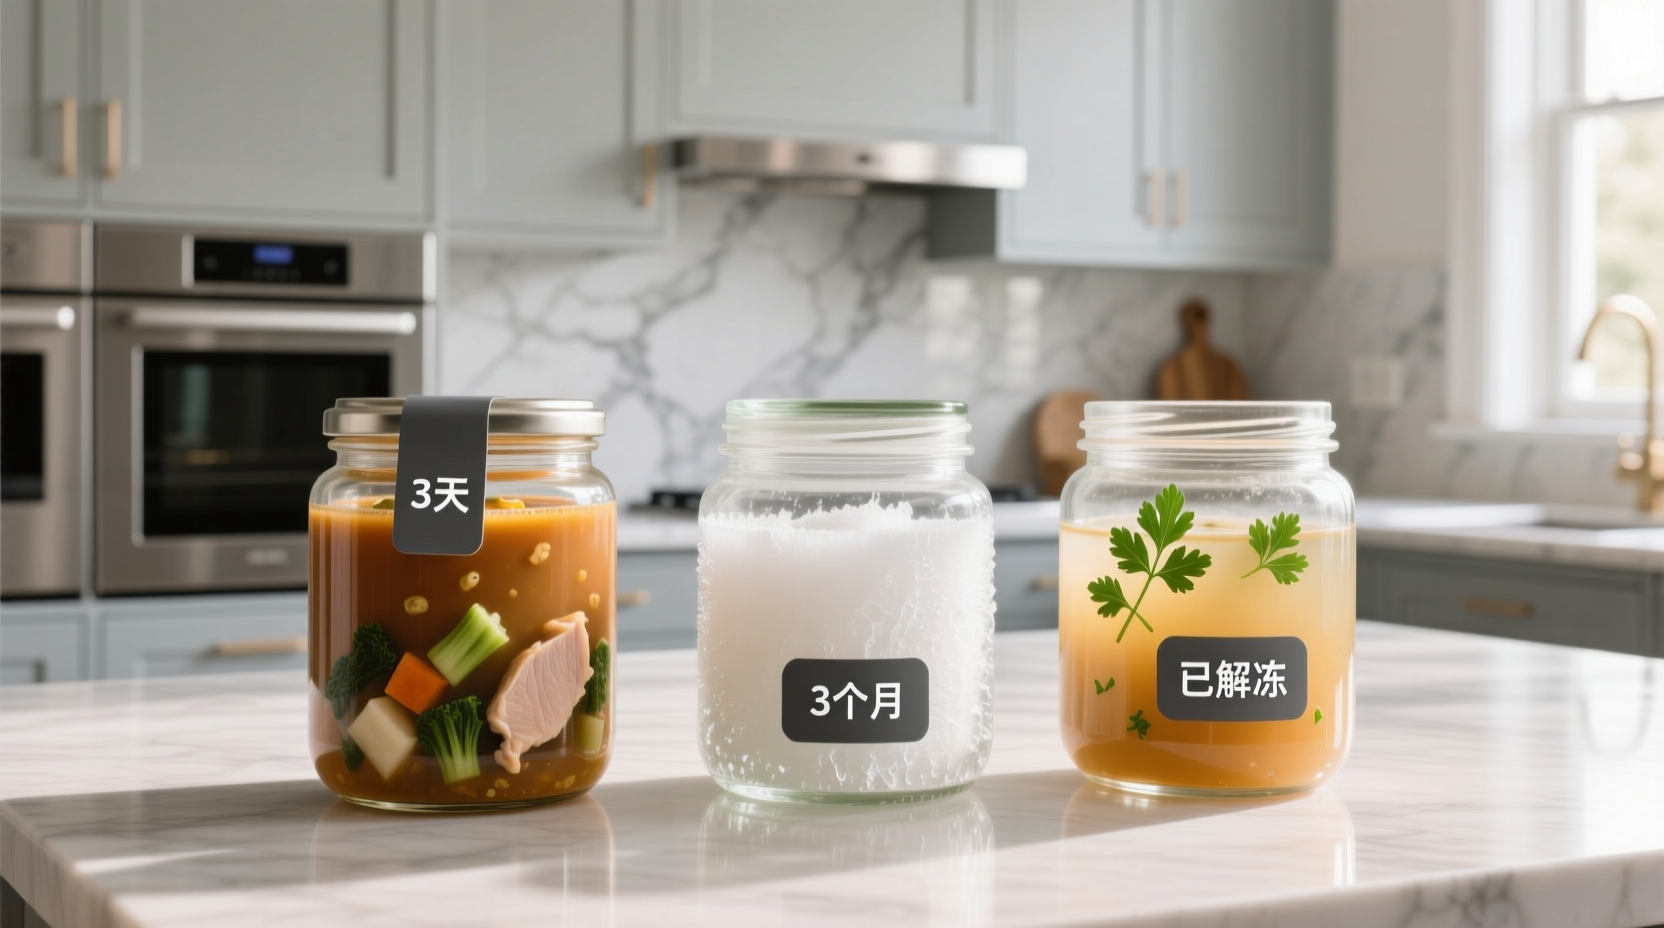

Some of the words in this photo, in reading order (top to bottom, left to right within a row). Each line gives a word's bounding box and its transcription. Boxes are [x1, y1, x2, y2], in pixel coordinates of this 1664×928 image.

[411, 477, 469, 514] 3天
[1180, 659, 1288, 699] 已解冻
[810, 681, 902, 721] 3个月
